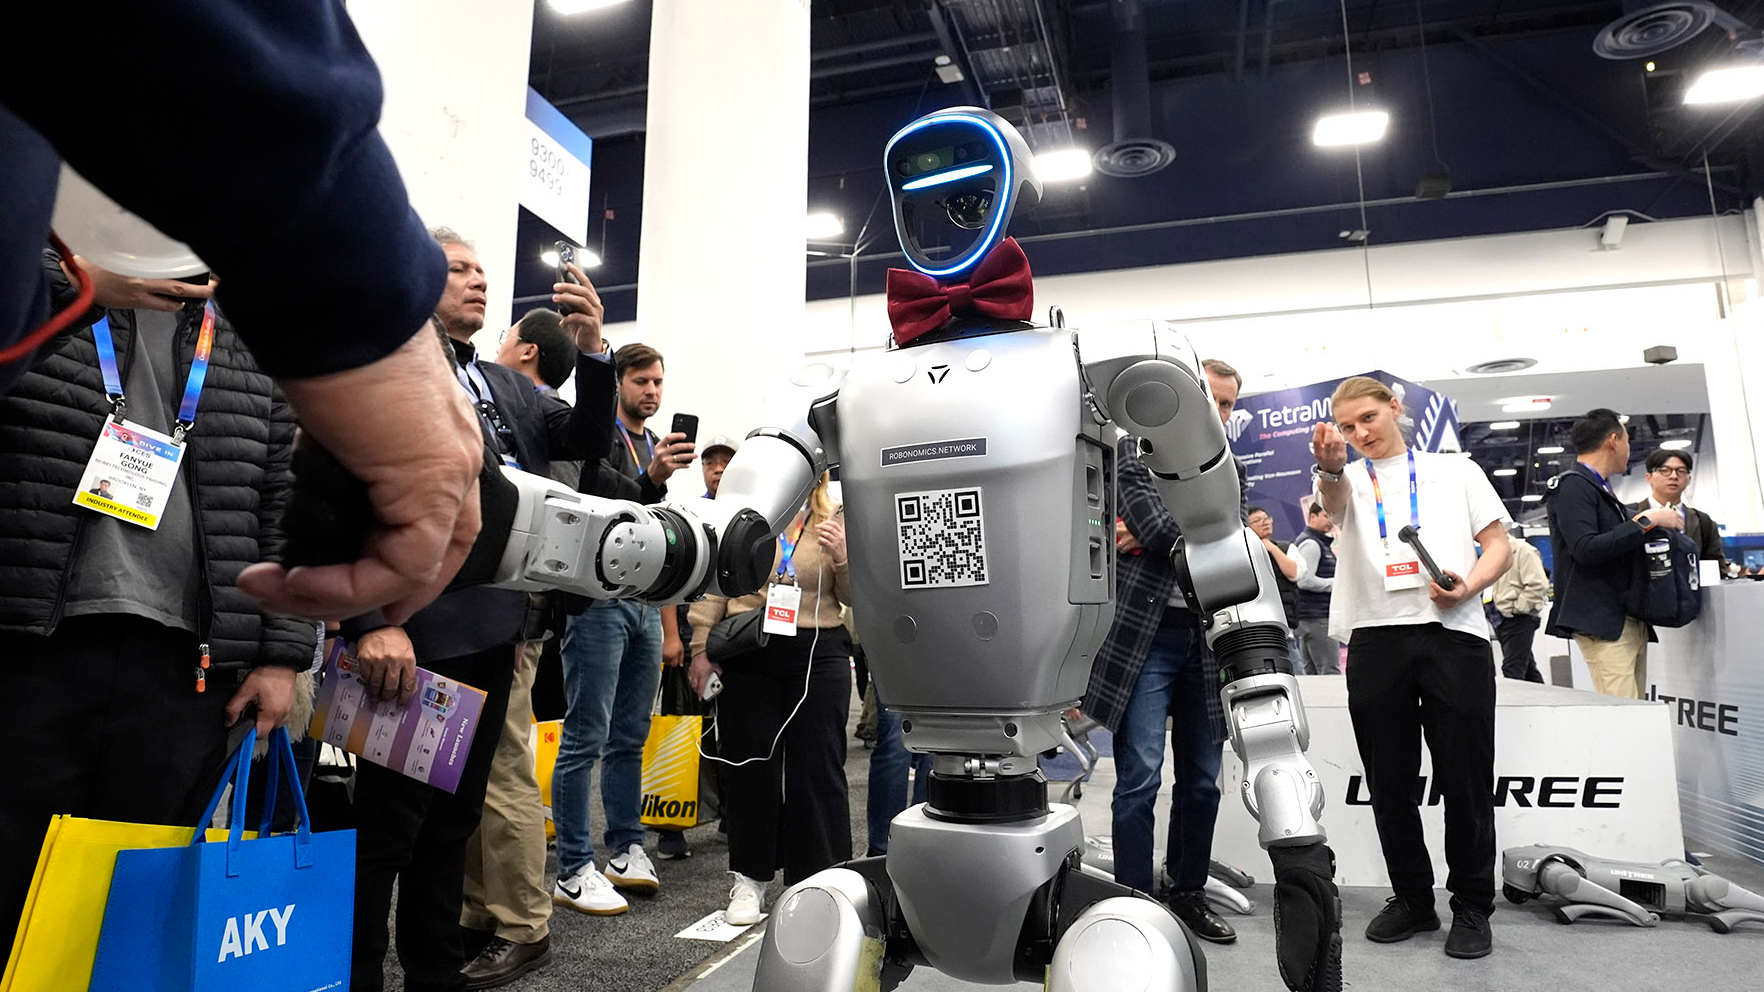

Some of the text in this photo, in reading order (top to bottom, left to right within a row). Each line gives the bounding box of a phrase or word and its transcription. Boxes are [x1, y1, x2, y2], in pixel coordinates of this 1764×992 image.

[530, 159, 562, 196] 9499
[140, 440, 162, 453] DIVE
[889, 443, 977, 460] ROBONOMICS.NETWORK
[119, 452, 153, 469] FANYUE
[120, 460, 148, 474] GONG
[86, 497, 117, 511] INDUSTRY
[118, 508, 148, 522] ATTENDEE
[1391, 564, 1413, 572] TCL
[773, 609, 790, 618] TCL
[1516, 860, 1530, 869] 02
[218, 903, 296, 963] AKY
